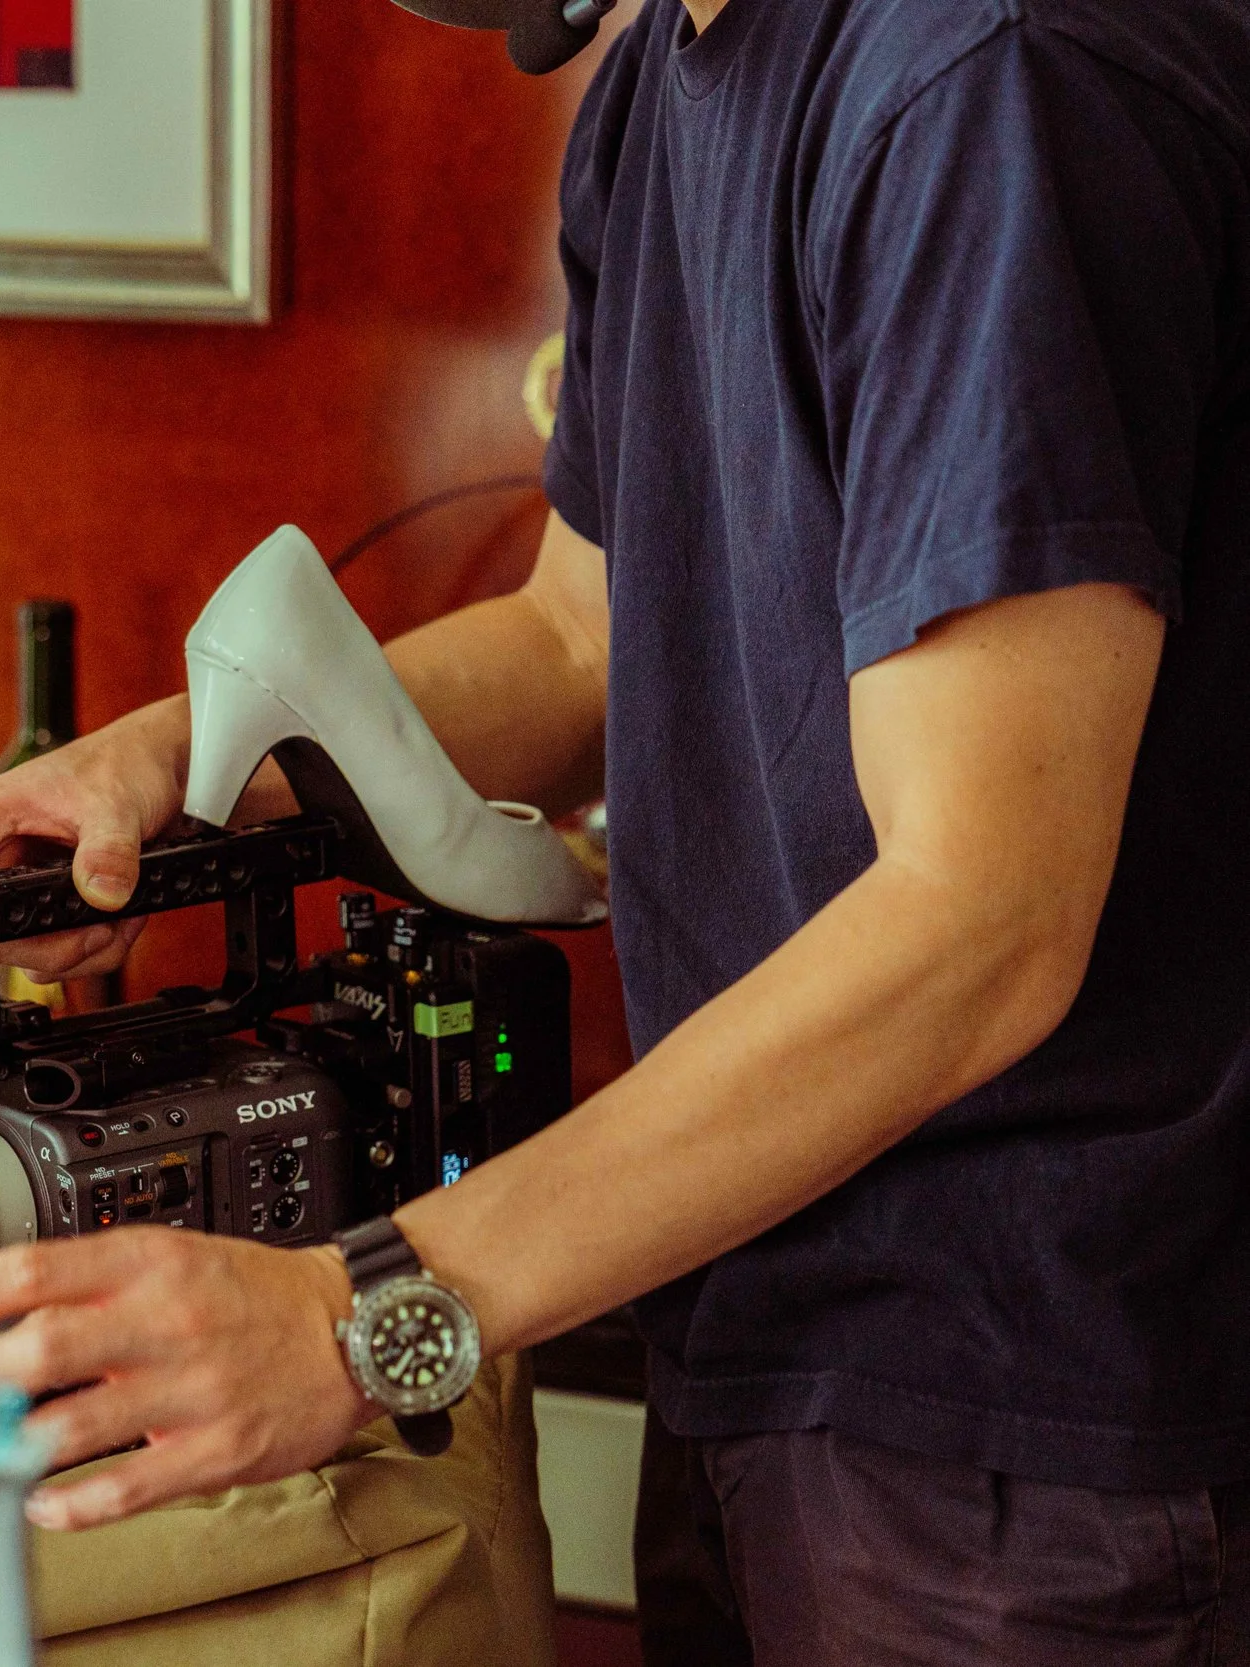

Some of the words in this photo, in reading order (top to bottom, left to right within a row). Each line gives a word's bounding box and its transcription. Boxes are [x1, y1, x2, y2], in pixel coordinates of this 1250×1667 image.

[236, 1090, 316, 1124] SONY
[110, 1122, 130, 1131] HOLD
[89, 1170, 116, 1181] PRESET
[135, 1193, 154, 1202] AUTO
[170, 1219, 183, 1227] IRIS
